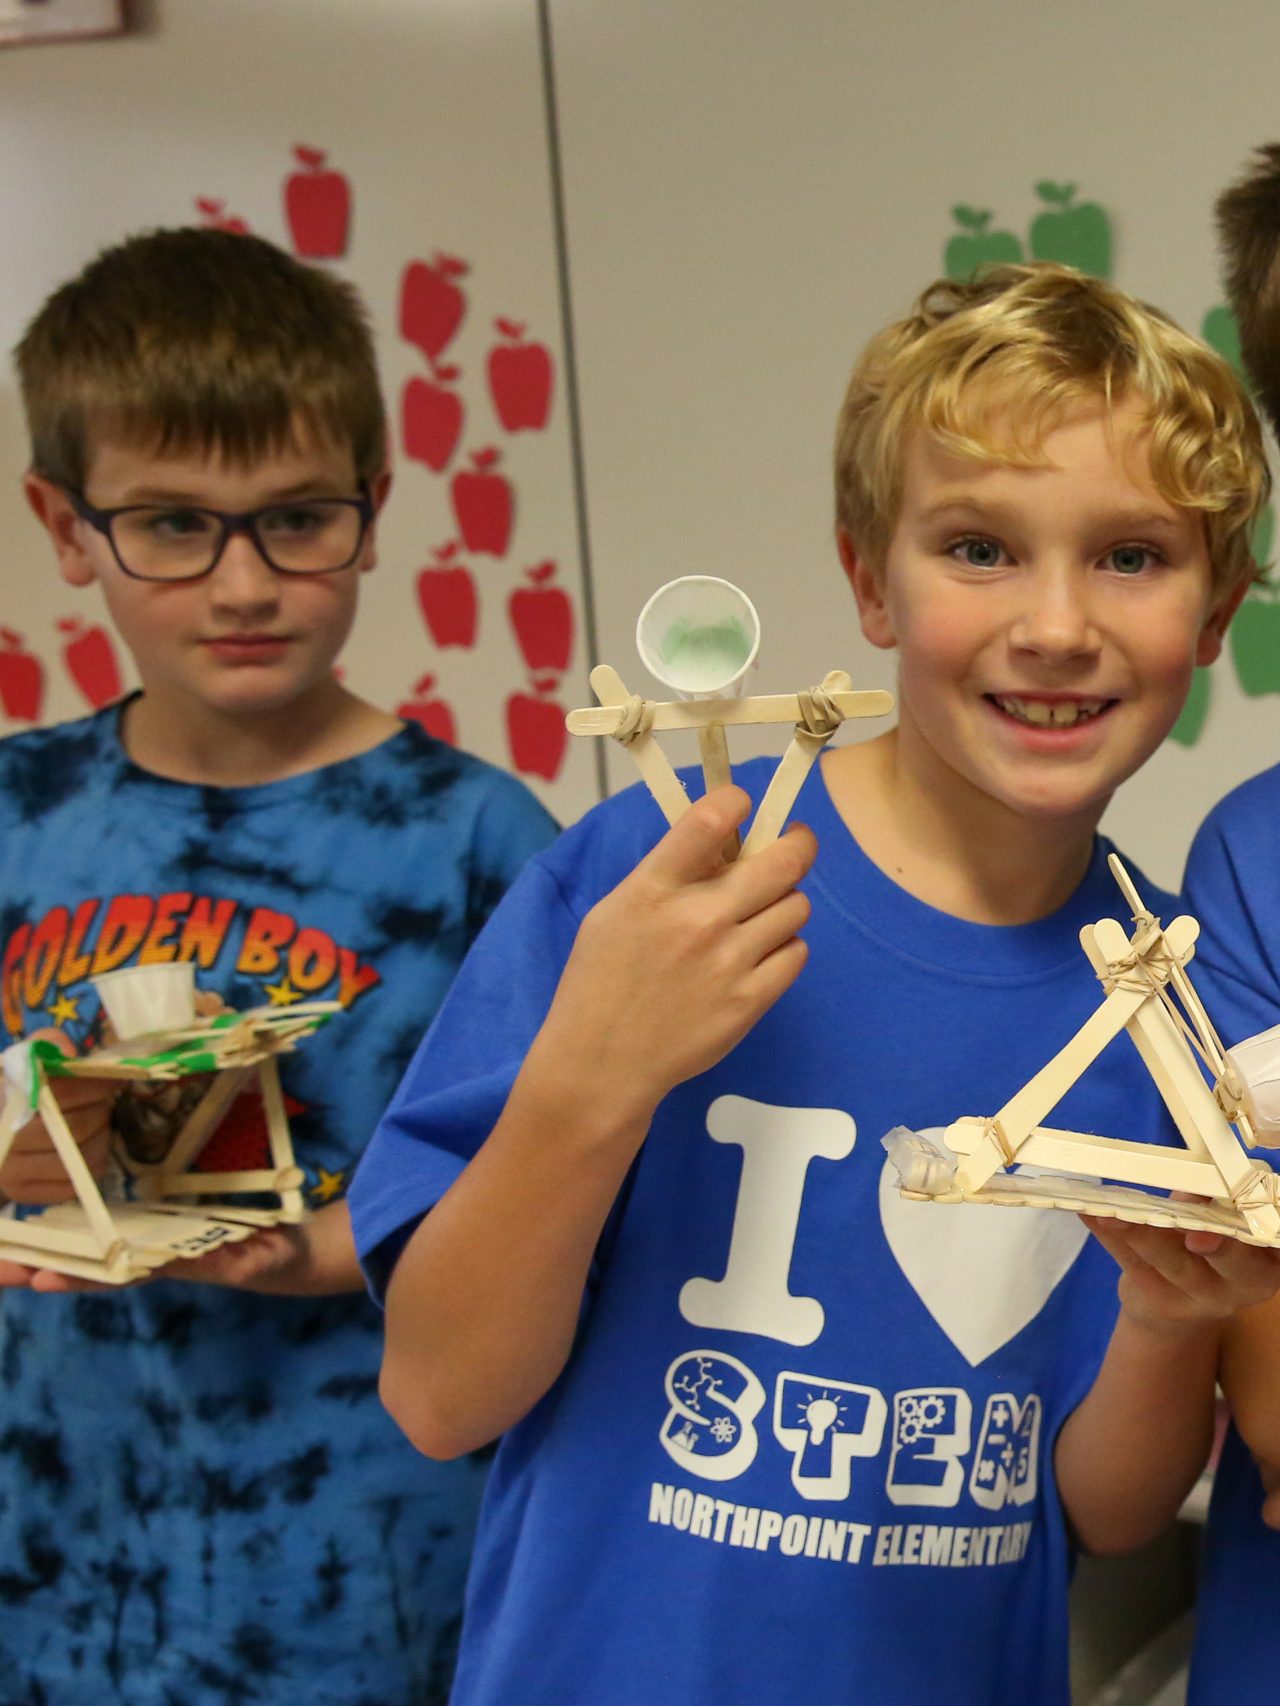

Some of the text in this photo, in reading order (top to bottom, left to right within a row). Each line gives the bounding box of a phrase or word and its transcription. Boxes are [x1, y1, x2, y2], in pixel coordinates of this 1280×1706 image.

[2, 892, 381, 1035] GOLDEN BOY
[678, 1093, 857, 1347] I
[659, 1349, 1042, 1511] STEM
[648, 1482, 1033, 1567] NORTHPOINT ELEMENTARY
